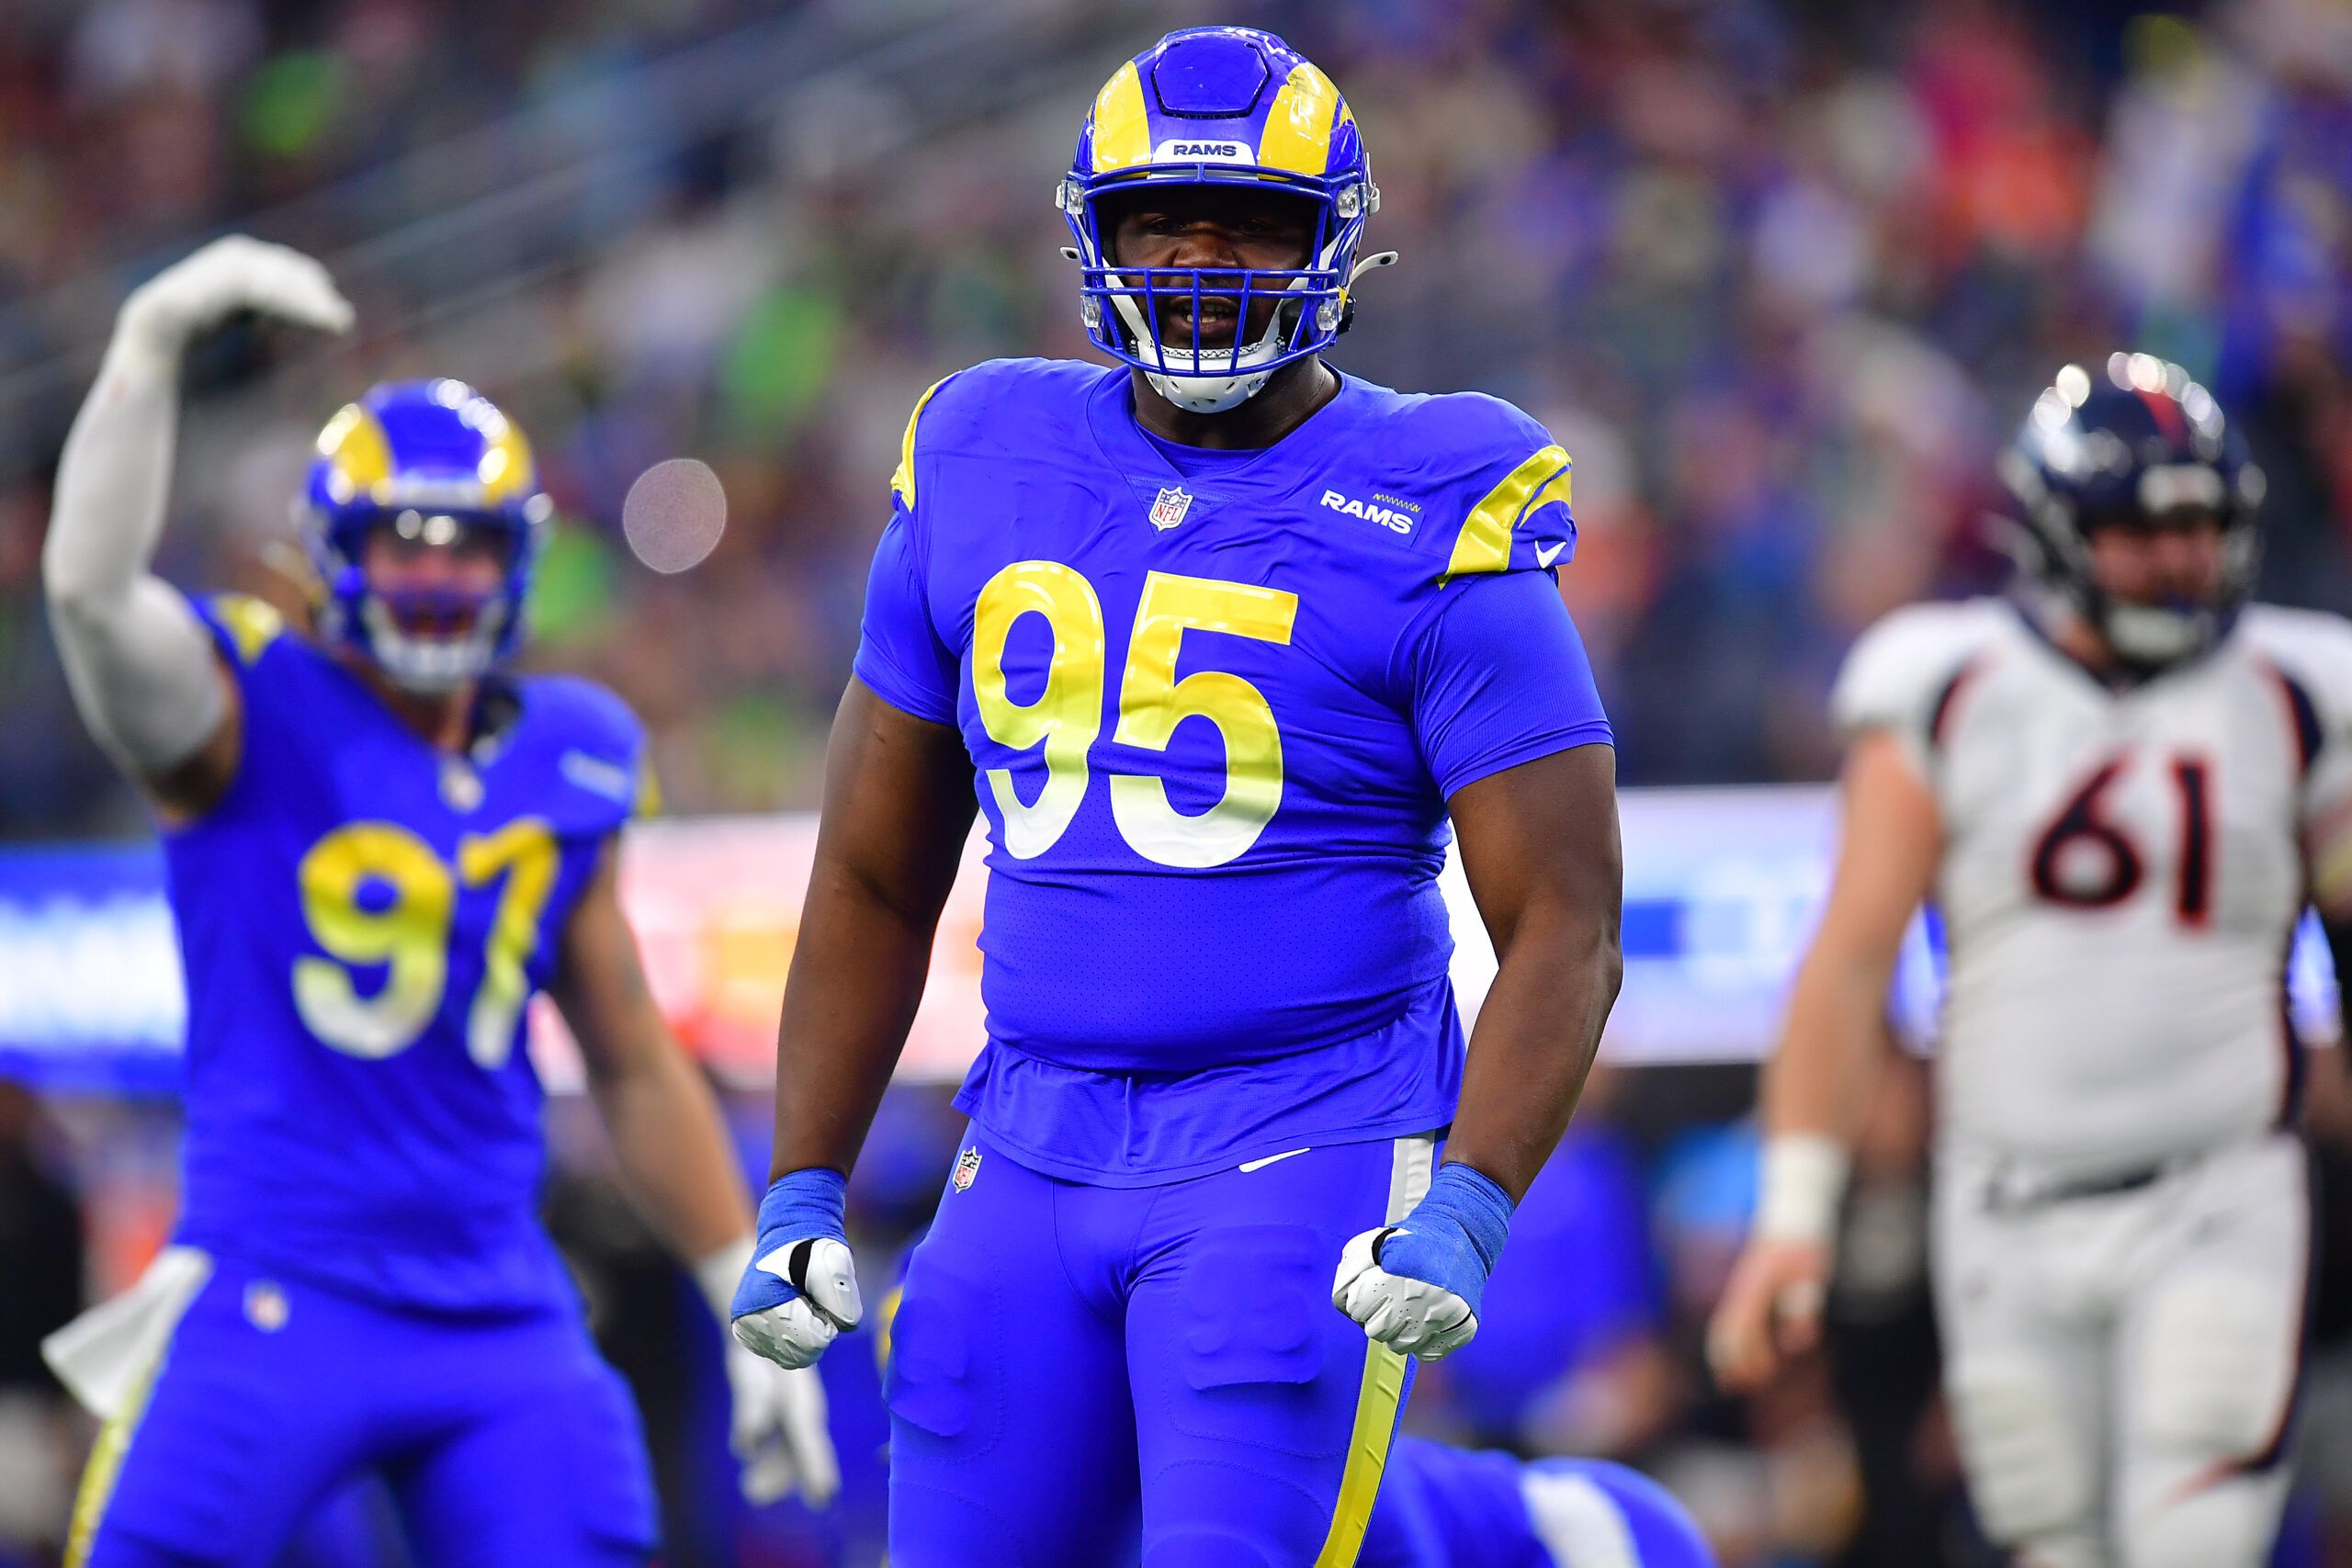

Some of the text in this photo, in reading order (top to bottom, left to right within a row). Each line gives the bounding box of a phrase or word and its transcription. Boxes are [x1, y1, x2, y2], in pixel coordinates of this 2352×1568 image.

[1173, 144, 1237, 156] RAMS
[1155, 503, 1179, 522] NFL
[1320, 489, 1414, 535] RAMS
[973, 560, 1298, 868] 95
[2028, 751, 2211, 930] 61
